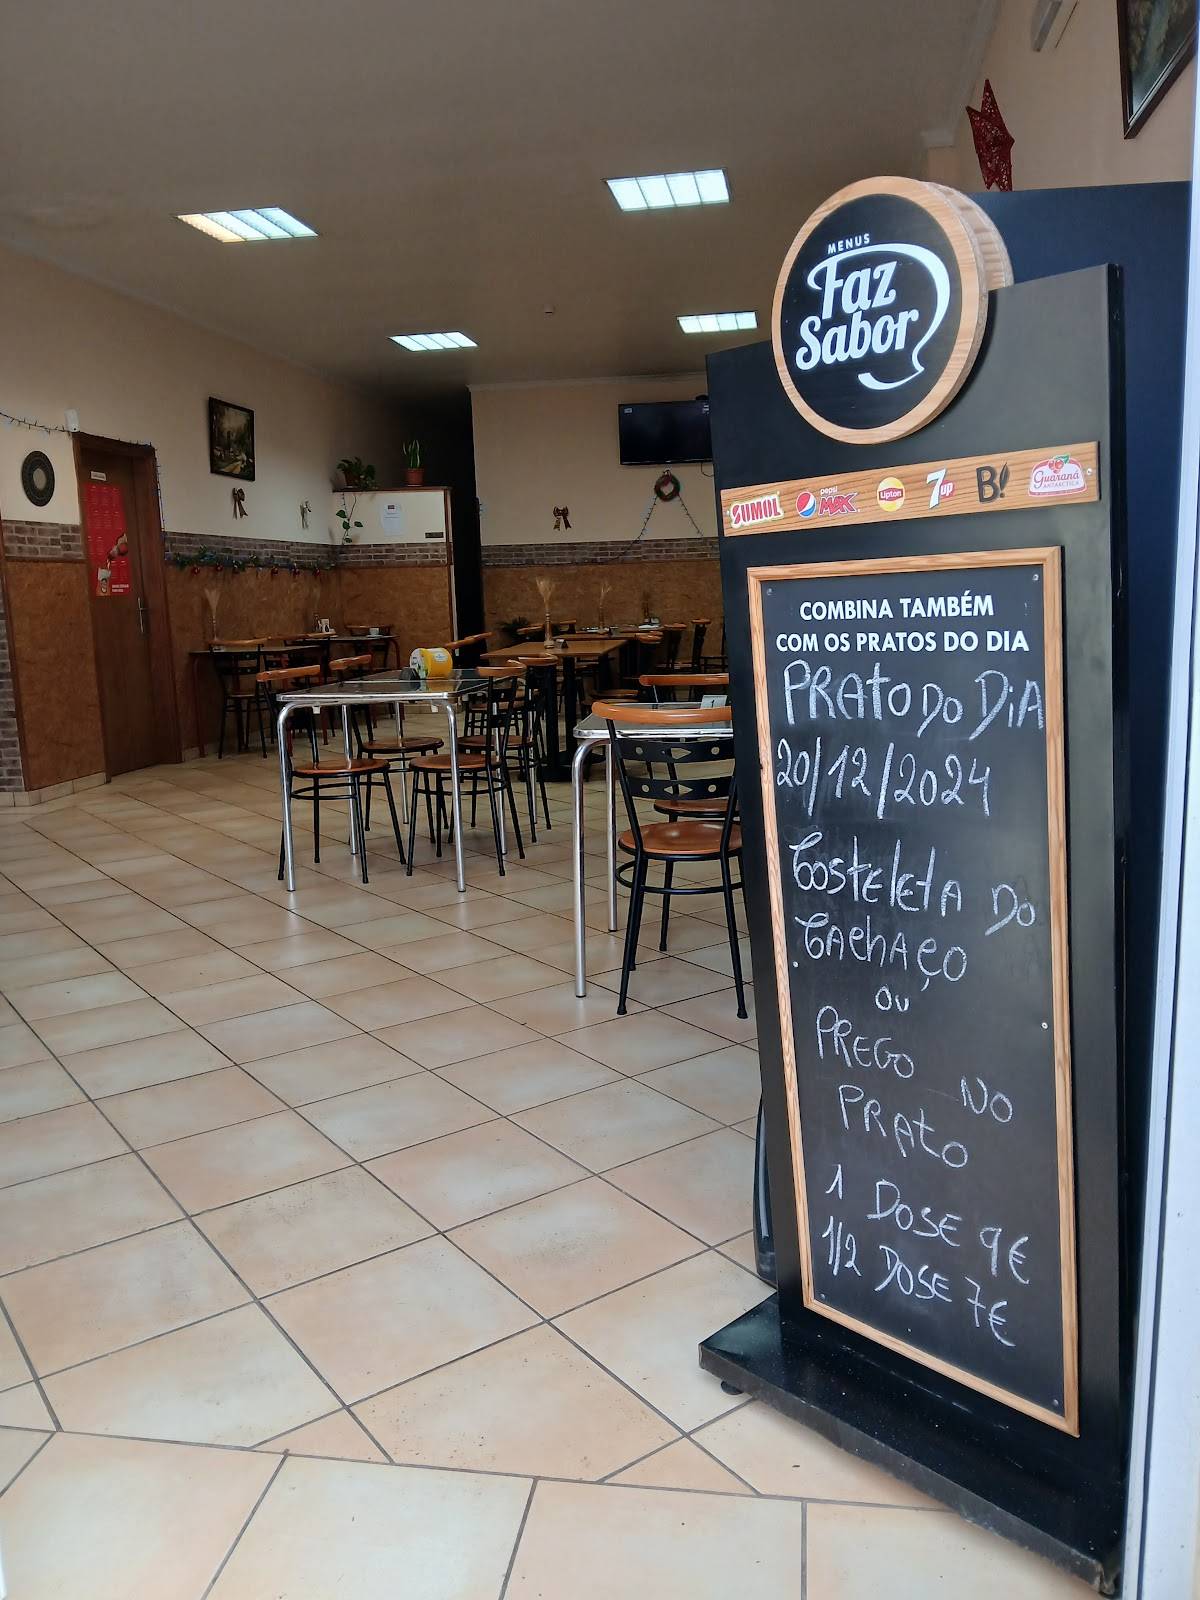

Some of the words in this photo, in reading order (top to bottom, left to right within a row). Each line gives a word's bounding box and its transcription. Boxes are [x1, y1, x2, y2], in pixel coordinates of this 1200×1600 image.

[827, 233, 870, 254] MENUS
[808, 258, 897, 320] Faz
[795, 309, 920, 371] Sabor
[820, 486, 838, 496] pepsi
[1034, 469, 1080, 489] Guaraná
[818, 492, 858, 517] MAX
[879, 489, 903, 500] Lipton
[731, 496, 782, 525] SUMOL
[799, 599, 894, 621] COMBINA
[900, 590, 994, 619] TAMBÉM
[776, 633, 819, 652] COM
[824, 633, 850, 652] OS
[856, 632, 937, 652] PRATOS
[943, 631, 979, 652] DO
[986, 630, 1030, 652] DIA
[776, 736, 991, 820] 20/12/2024
[816, 1005, 915, 1079] PREGO
[960, 1075, 1014, 1123] NO
[825, 1163, 843, 1200] 1
[866, 1178, 963, 1248] DOSE
[821, 1215, 863, 1277] 1/2
[874, 1244, 953, 1303] DOSE
